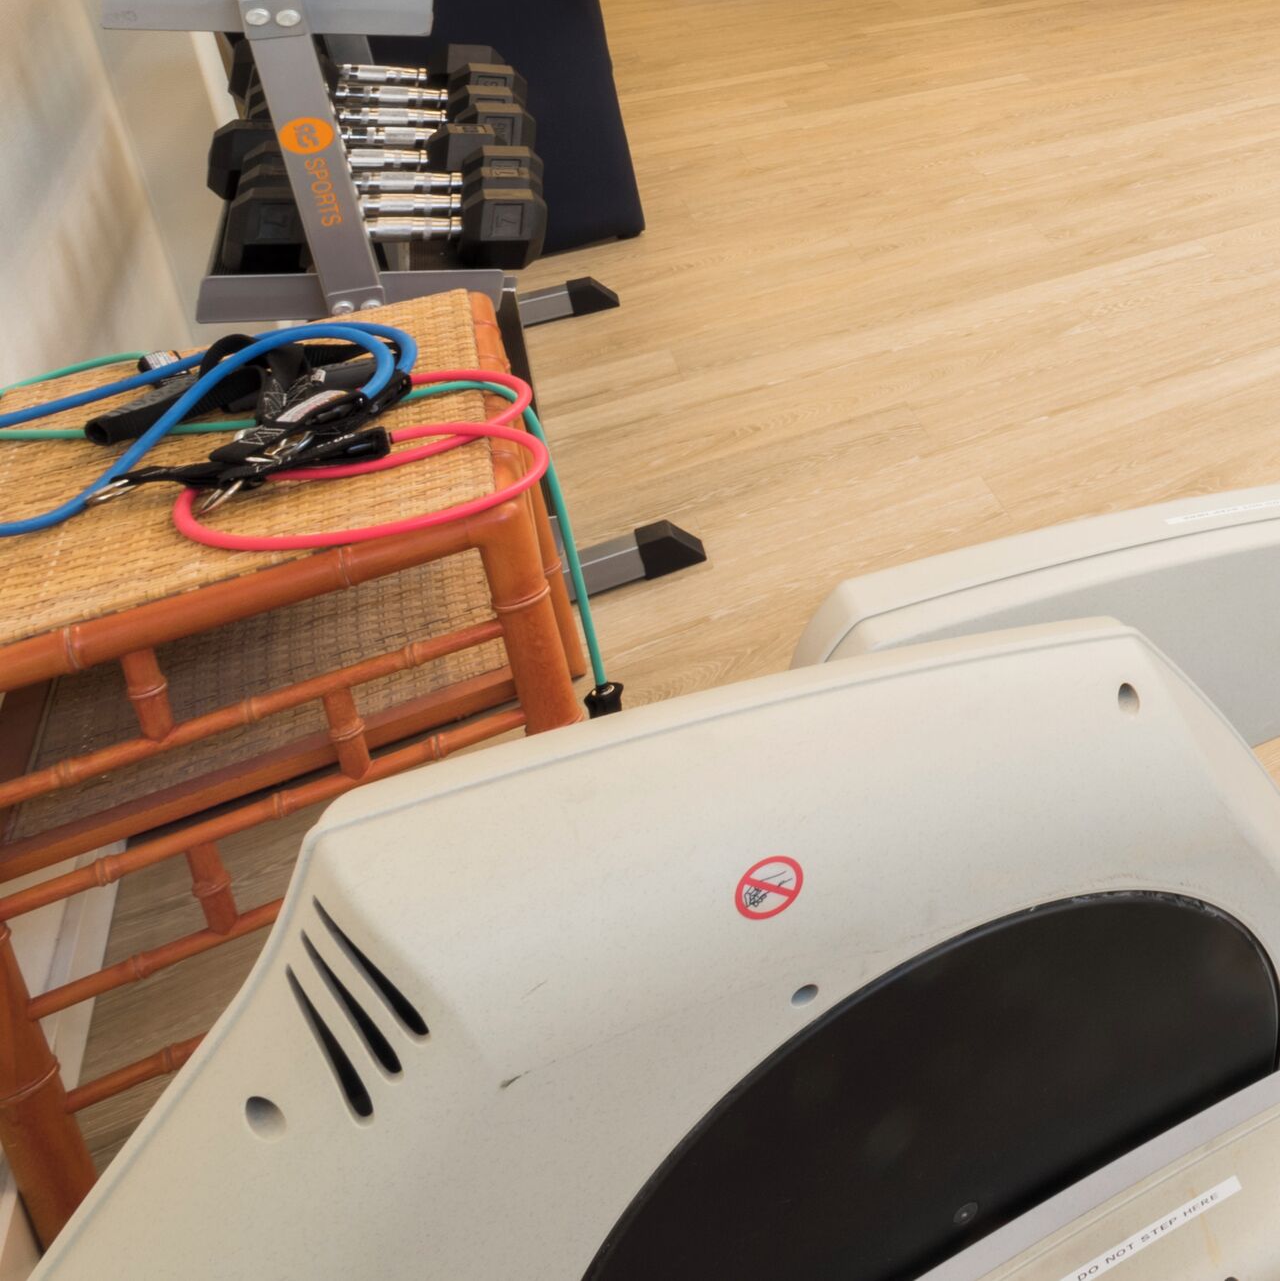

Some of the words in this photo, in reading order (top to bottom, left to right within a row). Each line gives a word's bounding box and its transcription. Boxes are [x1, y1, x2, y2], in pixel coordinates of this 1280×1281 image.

[305, 158, 343, 227] SPORTS
[1077, 1265, 1099, 1281] DO
[1105, 1243, 1134, 1264] NOT
[1140, 1217, 1177, 1243] STEP
[1183, 1192, 1219, 1217] HERE
